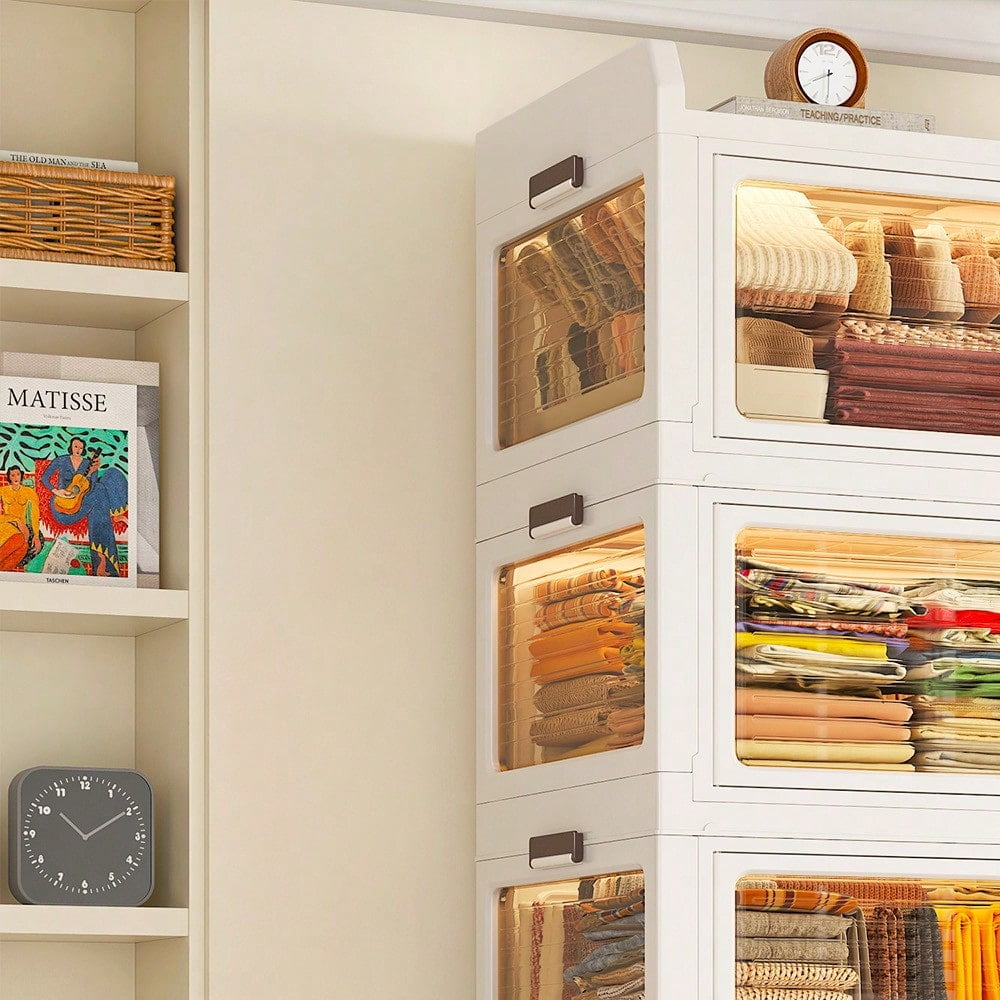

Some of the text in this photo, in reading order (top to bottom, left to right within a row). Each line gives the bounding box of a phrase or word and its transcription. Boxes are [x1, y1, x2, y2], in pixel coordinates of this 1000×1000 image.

[800, 108, 881, 125] TEACHING/PRACTICE
[10, 153, 28, 162] THE
[28, 156, 47, 164] OLD
[48, 158, 66, 166] MAN
[91, 161, 106, 169] SEA
[7, 388, 107, 412] MATISSE
[80, 781, 90, 790] 12
[56, 788, 66, 797] 11
[108, 789, 113, 798] 1
[38, 806, 51, 815] 10
[126, 807, 132, 816] 2
[29, 830, 36, 838] 9
[135, 832, 140, 841] 3
[38, 855, 44, 864] 8
[126, 855, 133, 864] 4
[57, 872, 63, 881] 7
[108, 872, 114, 881] 5
[81, 880, 88, 889] 6
